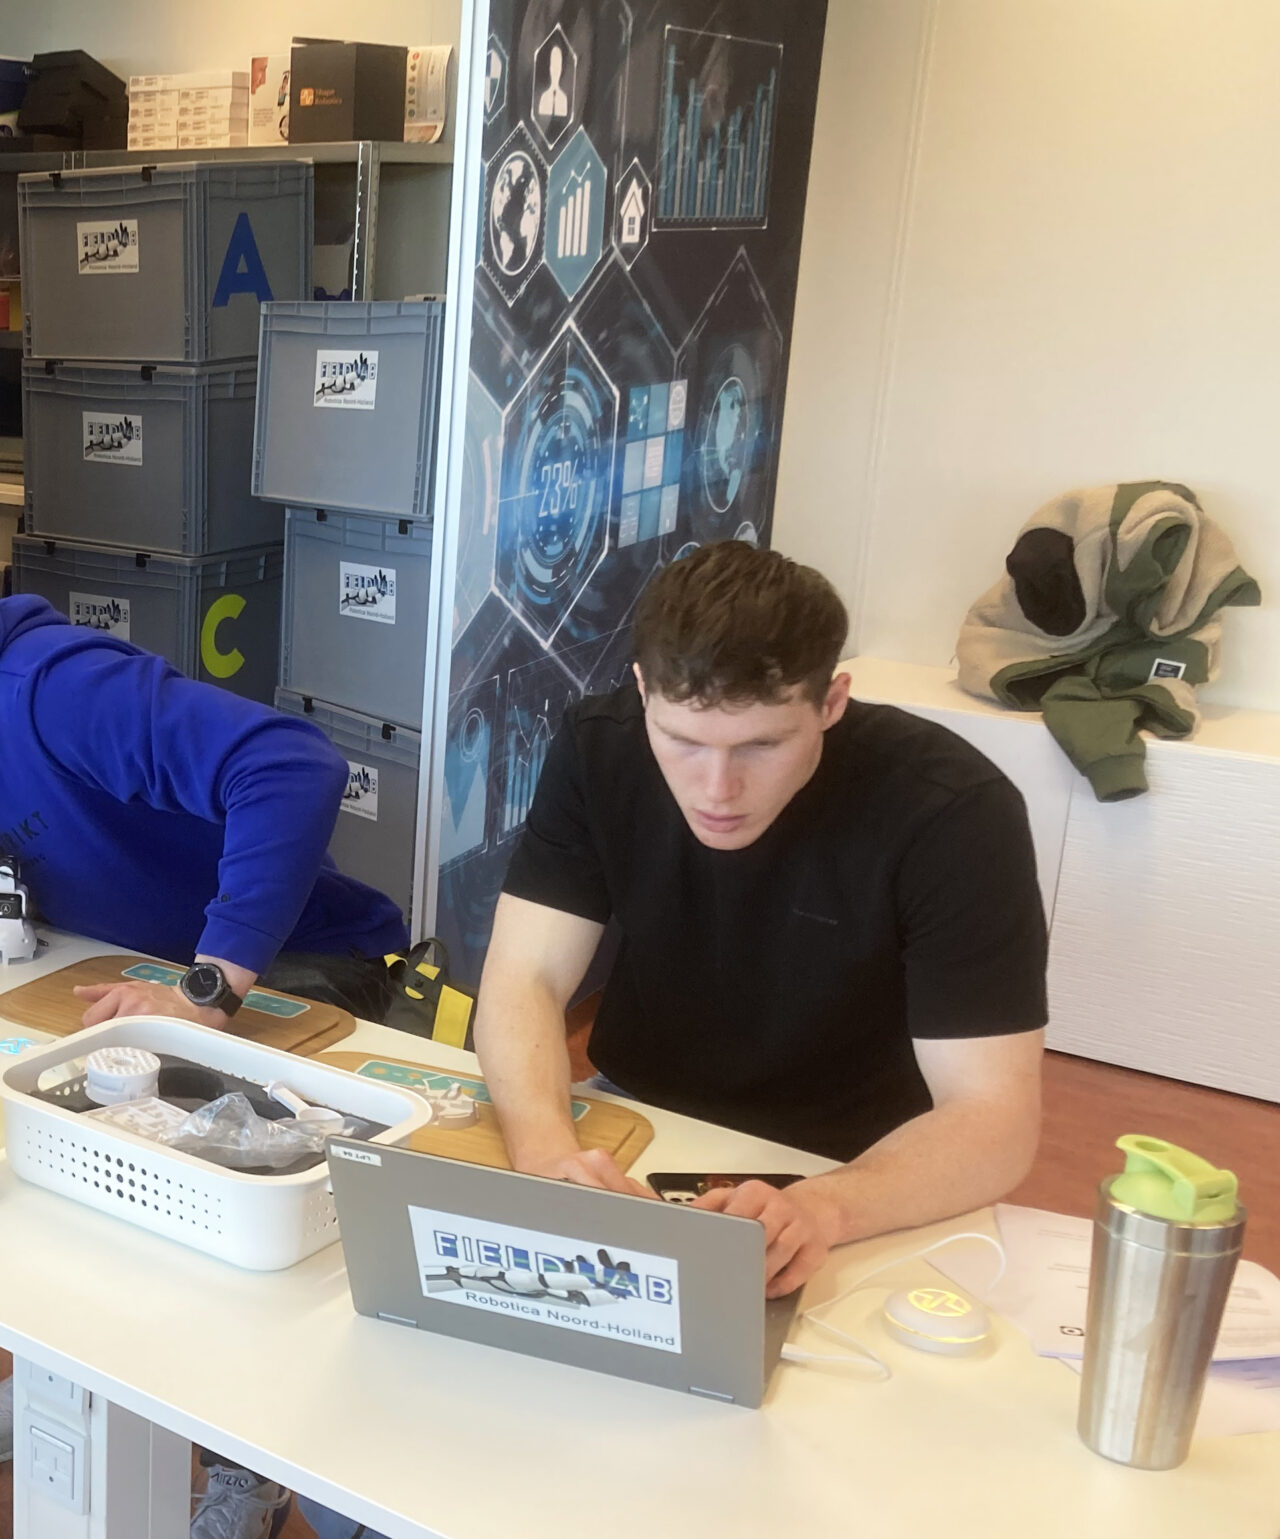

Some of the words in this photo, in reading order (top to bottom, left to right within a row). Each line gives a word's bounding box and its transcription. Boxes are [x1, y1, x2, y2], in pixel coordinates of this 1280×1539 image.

[213, 211, 275, 308] A
[538, 457, 579, 517] 23%
[200, 593, 247, 679] C
[465, 1291, 541, 1317] Robotica
[547, 1308, 676, 1347] Noord-Holland
